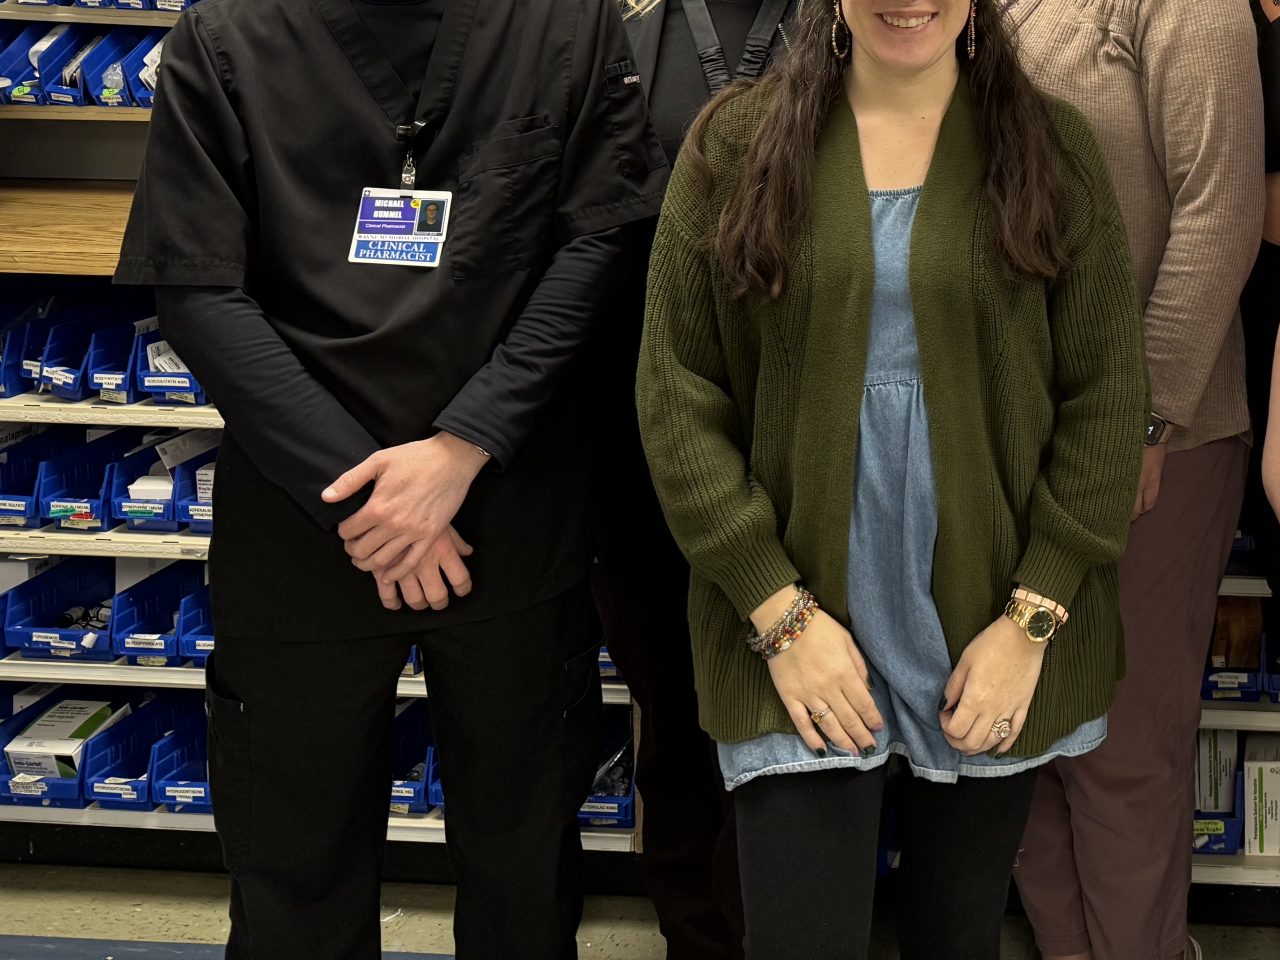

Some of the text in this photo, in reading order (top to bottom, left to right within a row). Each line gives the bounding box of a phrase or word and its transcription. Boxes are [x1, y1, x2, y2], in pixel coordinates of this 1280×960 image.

[374, 199, 404, 208] MICHAEL
[373, 210, 403, 219] HUMMEL
[368, 240, 427, 253] CLINICAL
[358, 249, 433, 261] PHARMACIST
